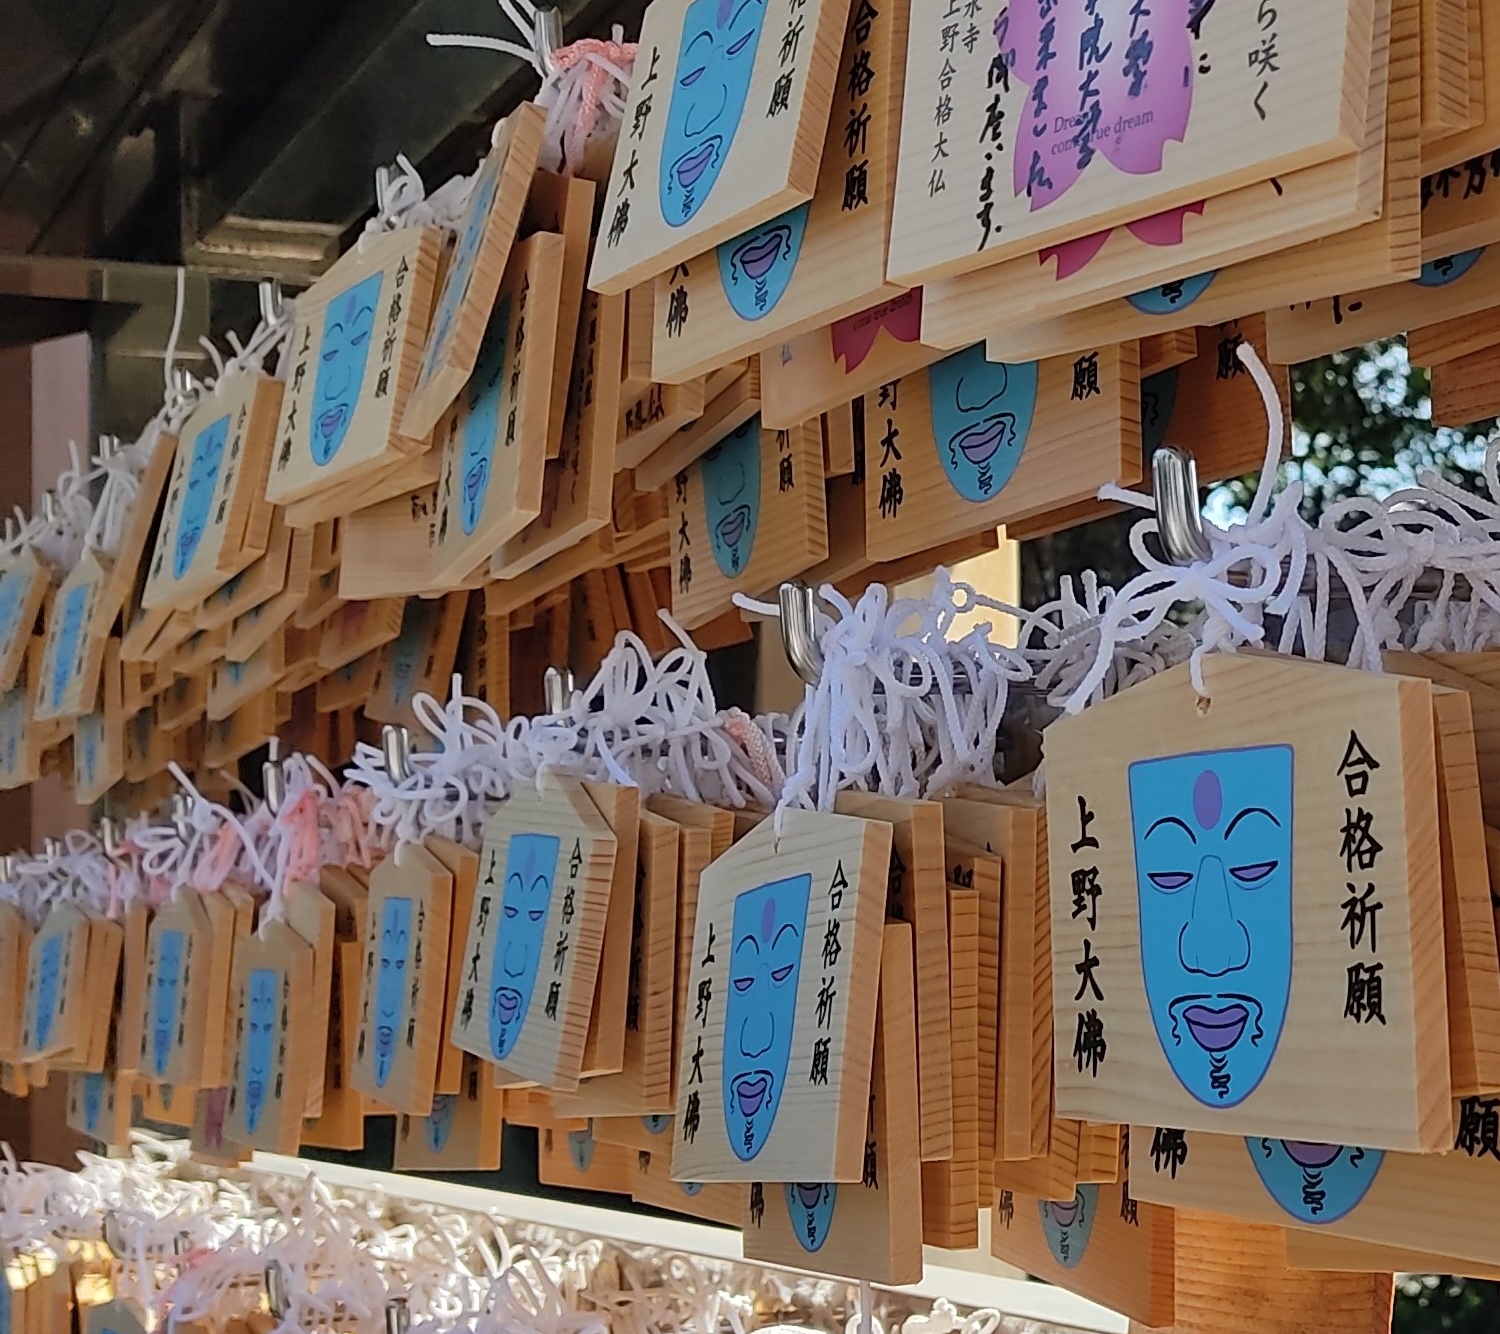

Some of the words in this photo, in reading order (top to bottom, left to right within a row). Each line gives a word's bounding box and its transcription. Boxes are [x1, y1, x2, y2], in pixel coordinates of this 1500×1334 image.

[607, 46, 661, 248] 上野大佛
[461, 849, 495, 1030] 上野大佛
[544, 837, 583, 1021] 合格祈願
[809, 859, 848, 1087] 合格祈願
[1070, 795, 1107, 1079] 上野大佛
[1336, 729, 1388, 1027] 合格祈願
[682, 923, 715, 1145] 上野大佛
